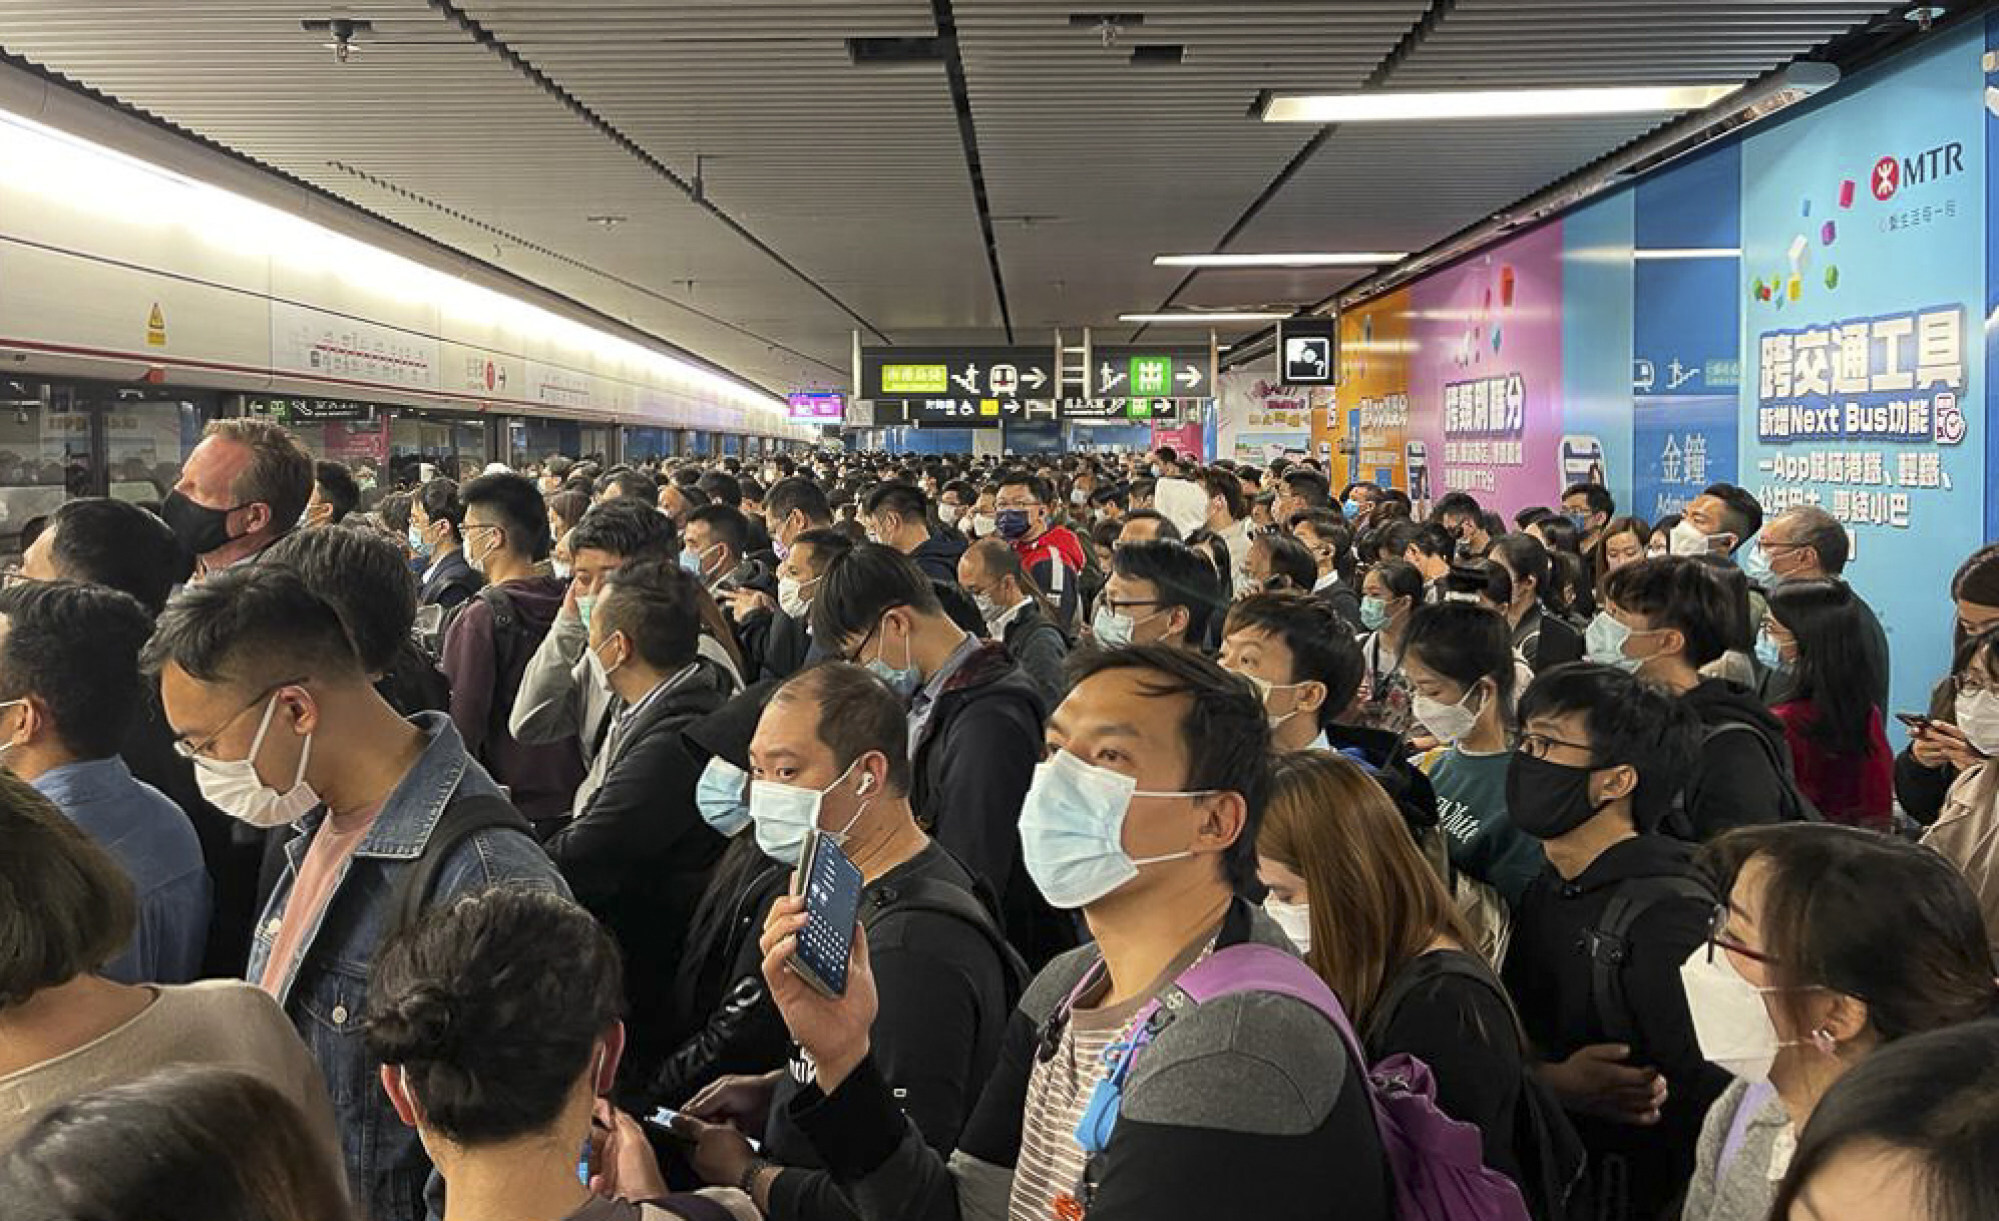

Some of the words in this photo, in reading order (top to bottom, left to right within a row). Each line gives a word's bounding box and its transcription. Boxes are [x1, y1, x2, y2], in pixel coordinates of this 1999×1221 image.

[1903, 141, 1964, 189] MTR
[1759, 309, 1962, 400] 跨交通工具
[1661, 432, 1709, 486] 金鐘
